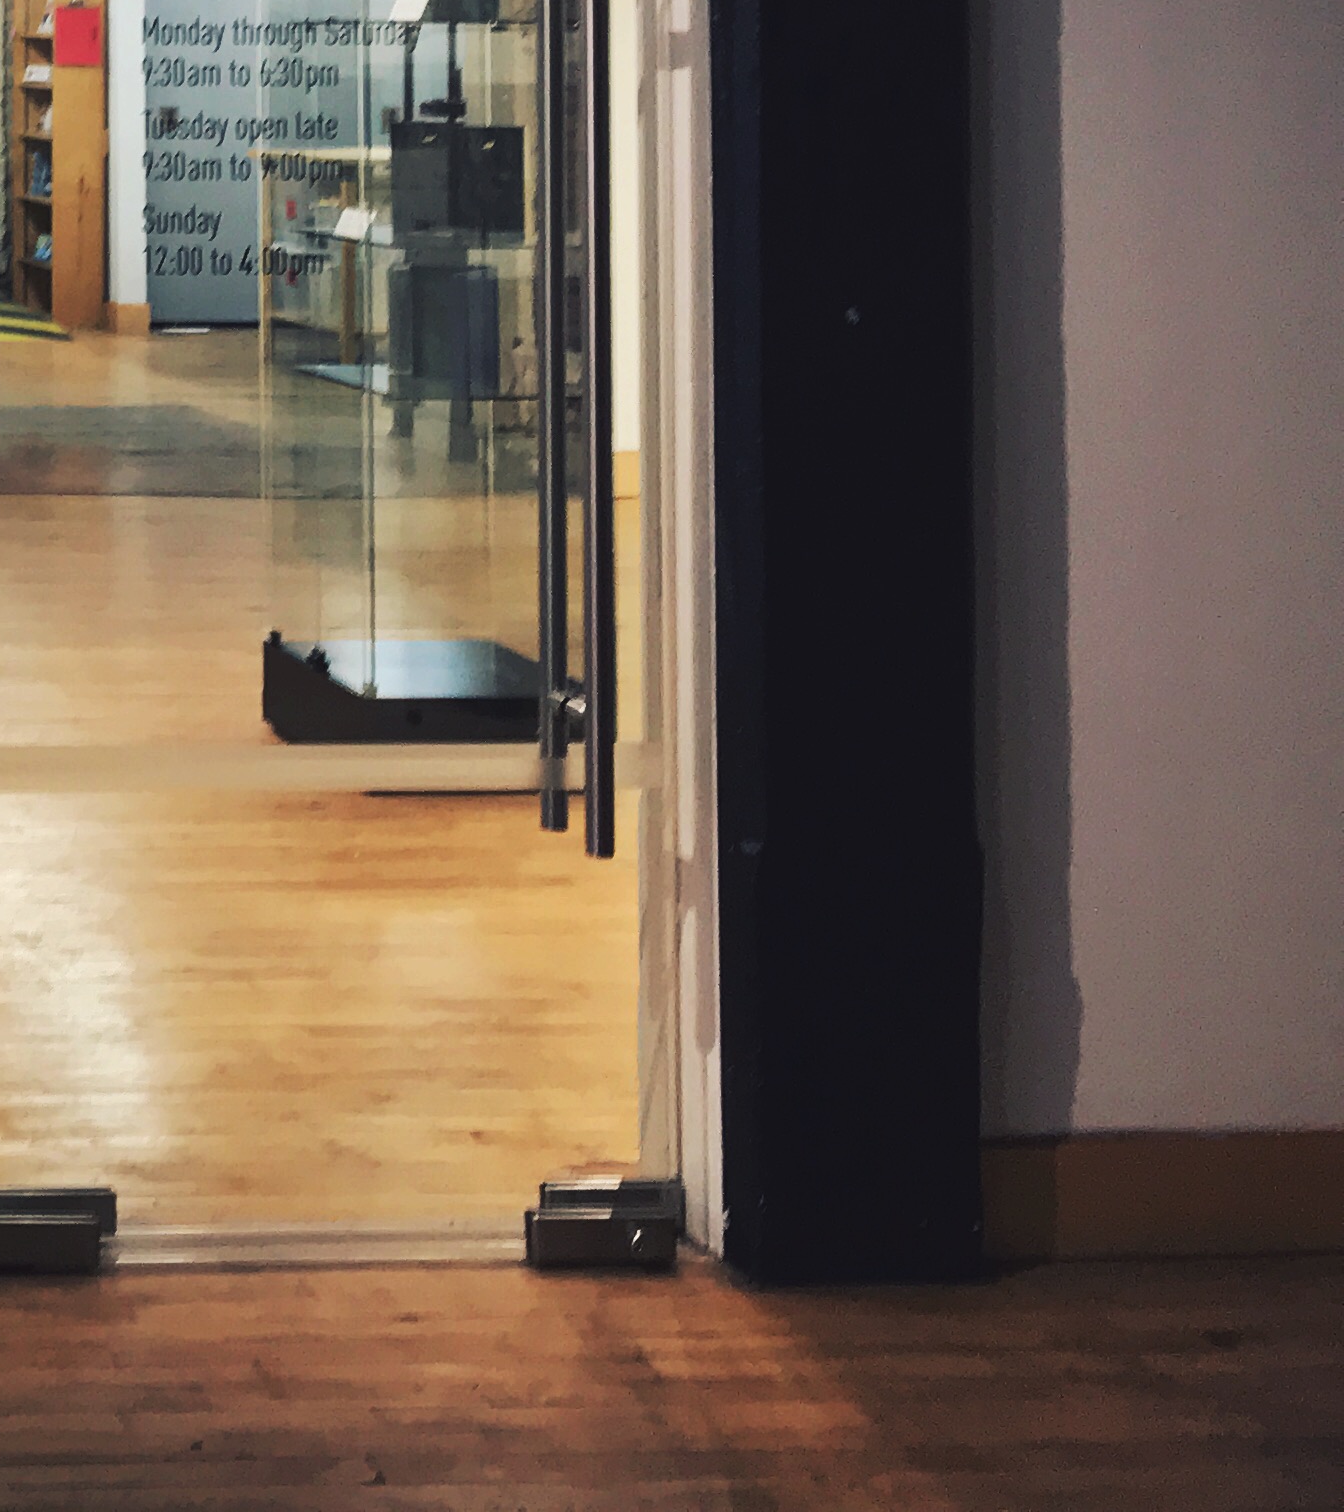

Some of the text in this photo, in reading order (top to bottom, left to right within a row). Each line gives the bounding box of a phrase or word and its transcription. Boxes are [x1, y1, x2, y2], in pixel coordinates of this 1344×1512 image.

[142, 15, 422, 53] Monday through Saturday
[142, 55, 221, 88] 9:30am
[229, 59, 251, 88] to
[142, 107, 338, 147] Tuesday open late
[142, 150, 222, 182] 9:30am
[229, 153, 252, 182] to
[142, 202, 222, 241] Sunday
[144, 244, 203, 276] 12:00
[211, 247, 233, 277] to
